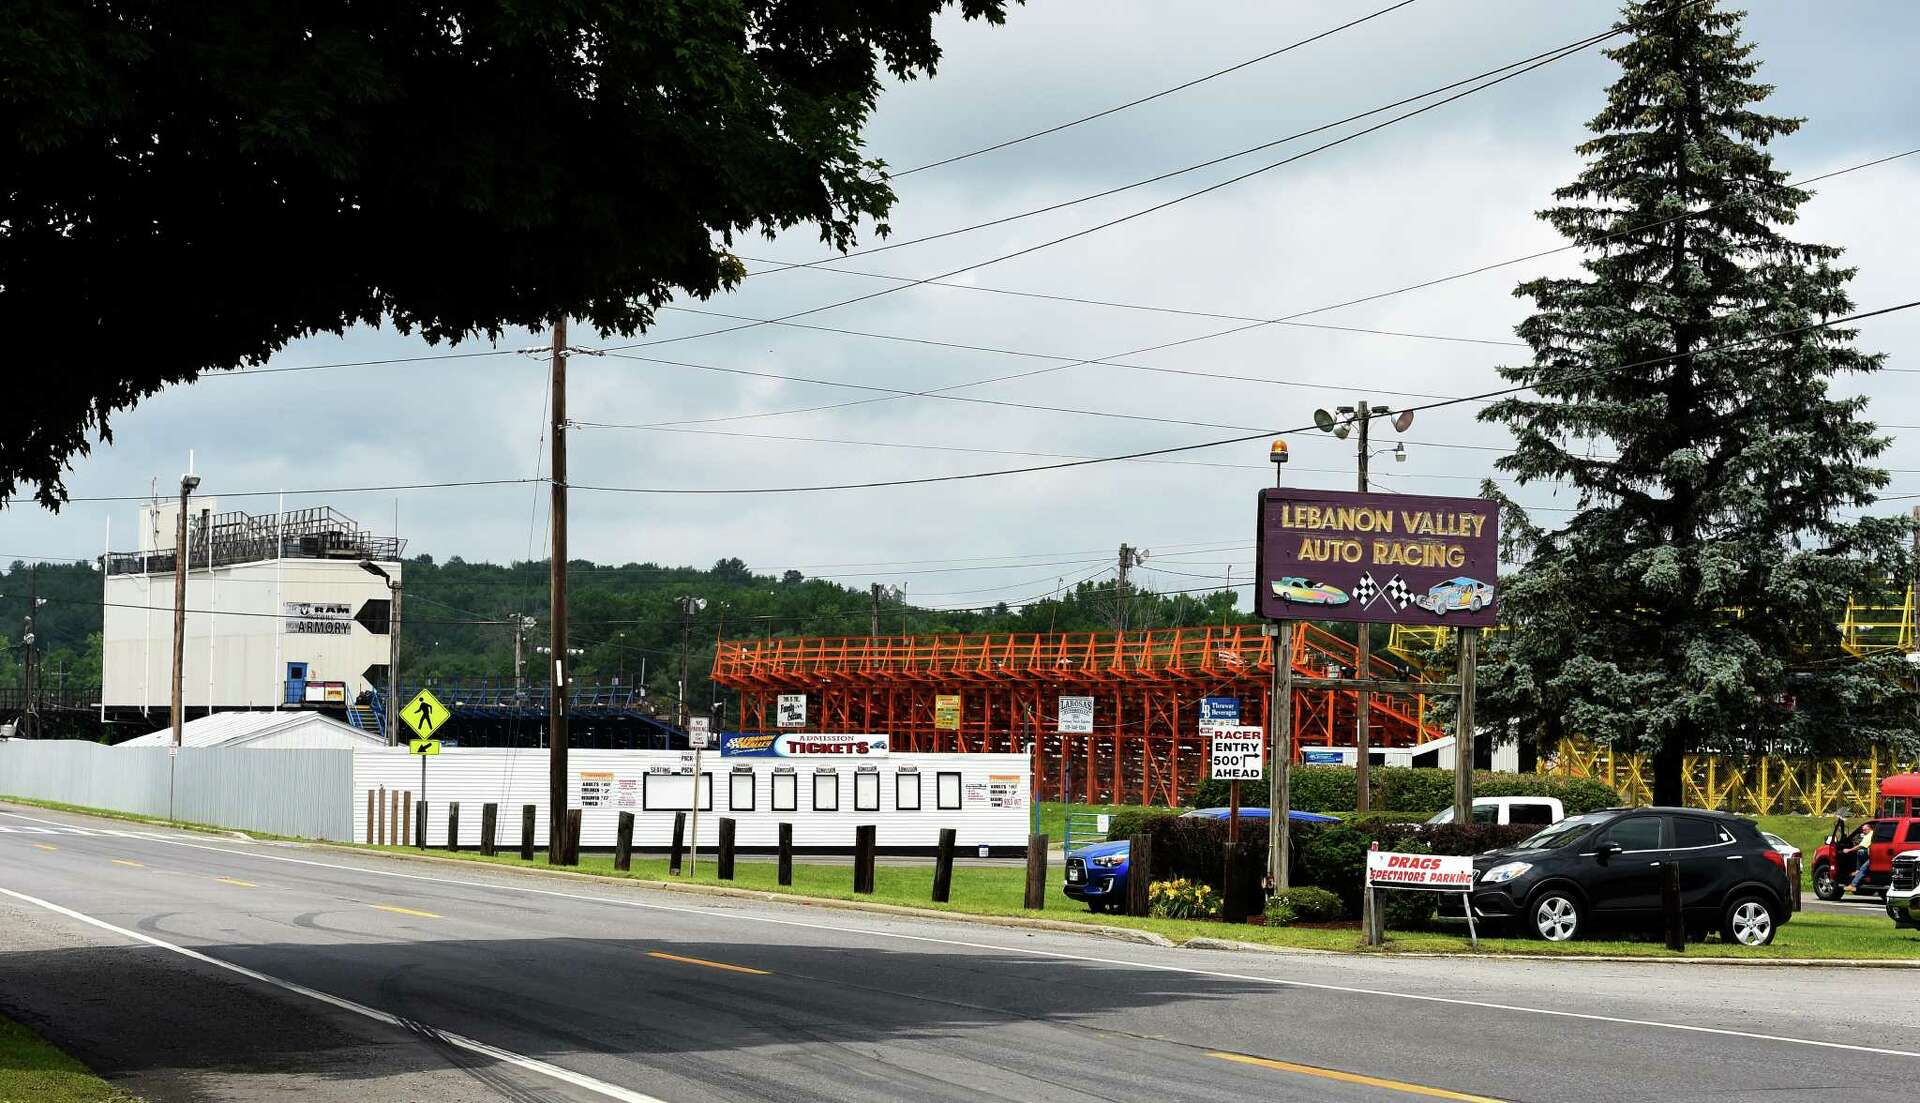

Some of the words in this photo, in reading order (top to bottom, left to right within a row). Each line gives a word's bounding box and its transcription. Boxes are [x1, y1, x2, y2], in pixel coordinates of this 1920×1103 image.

[1281, 505, 1393, 533] LEBANON
[1401, 510, 1487, 538] VALLEY
[1297, 538, 1363, 564] AUTO
[1372, 542, 1466, 568] RACING
[298, 621, 349, 634] ARMORY
[1214, 731, 1262, 740] RACER
[786, 741, 870, 755] TICKETS
[1215, 742, 1259, 752] ENTRY
[1214, 768, 1260, 778] AHEAD
[1387, 856, 1442, 870] DRAGS
[1369, 869, 1426, 882] SPECTATORS
[1429, 872, 1472, 884] PARKING
